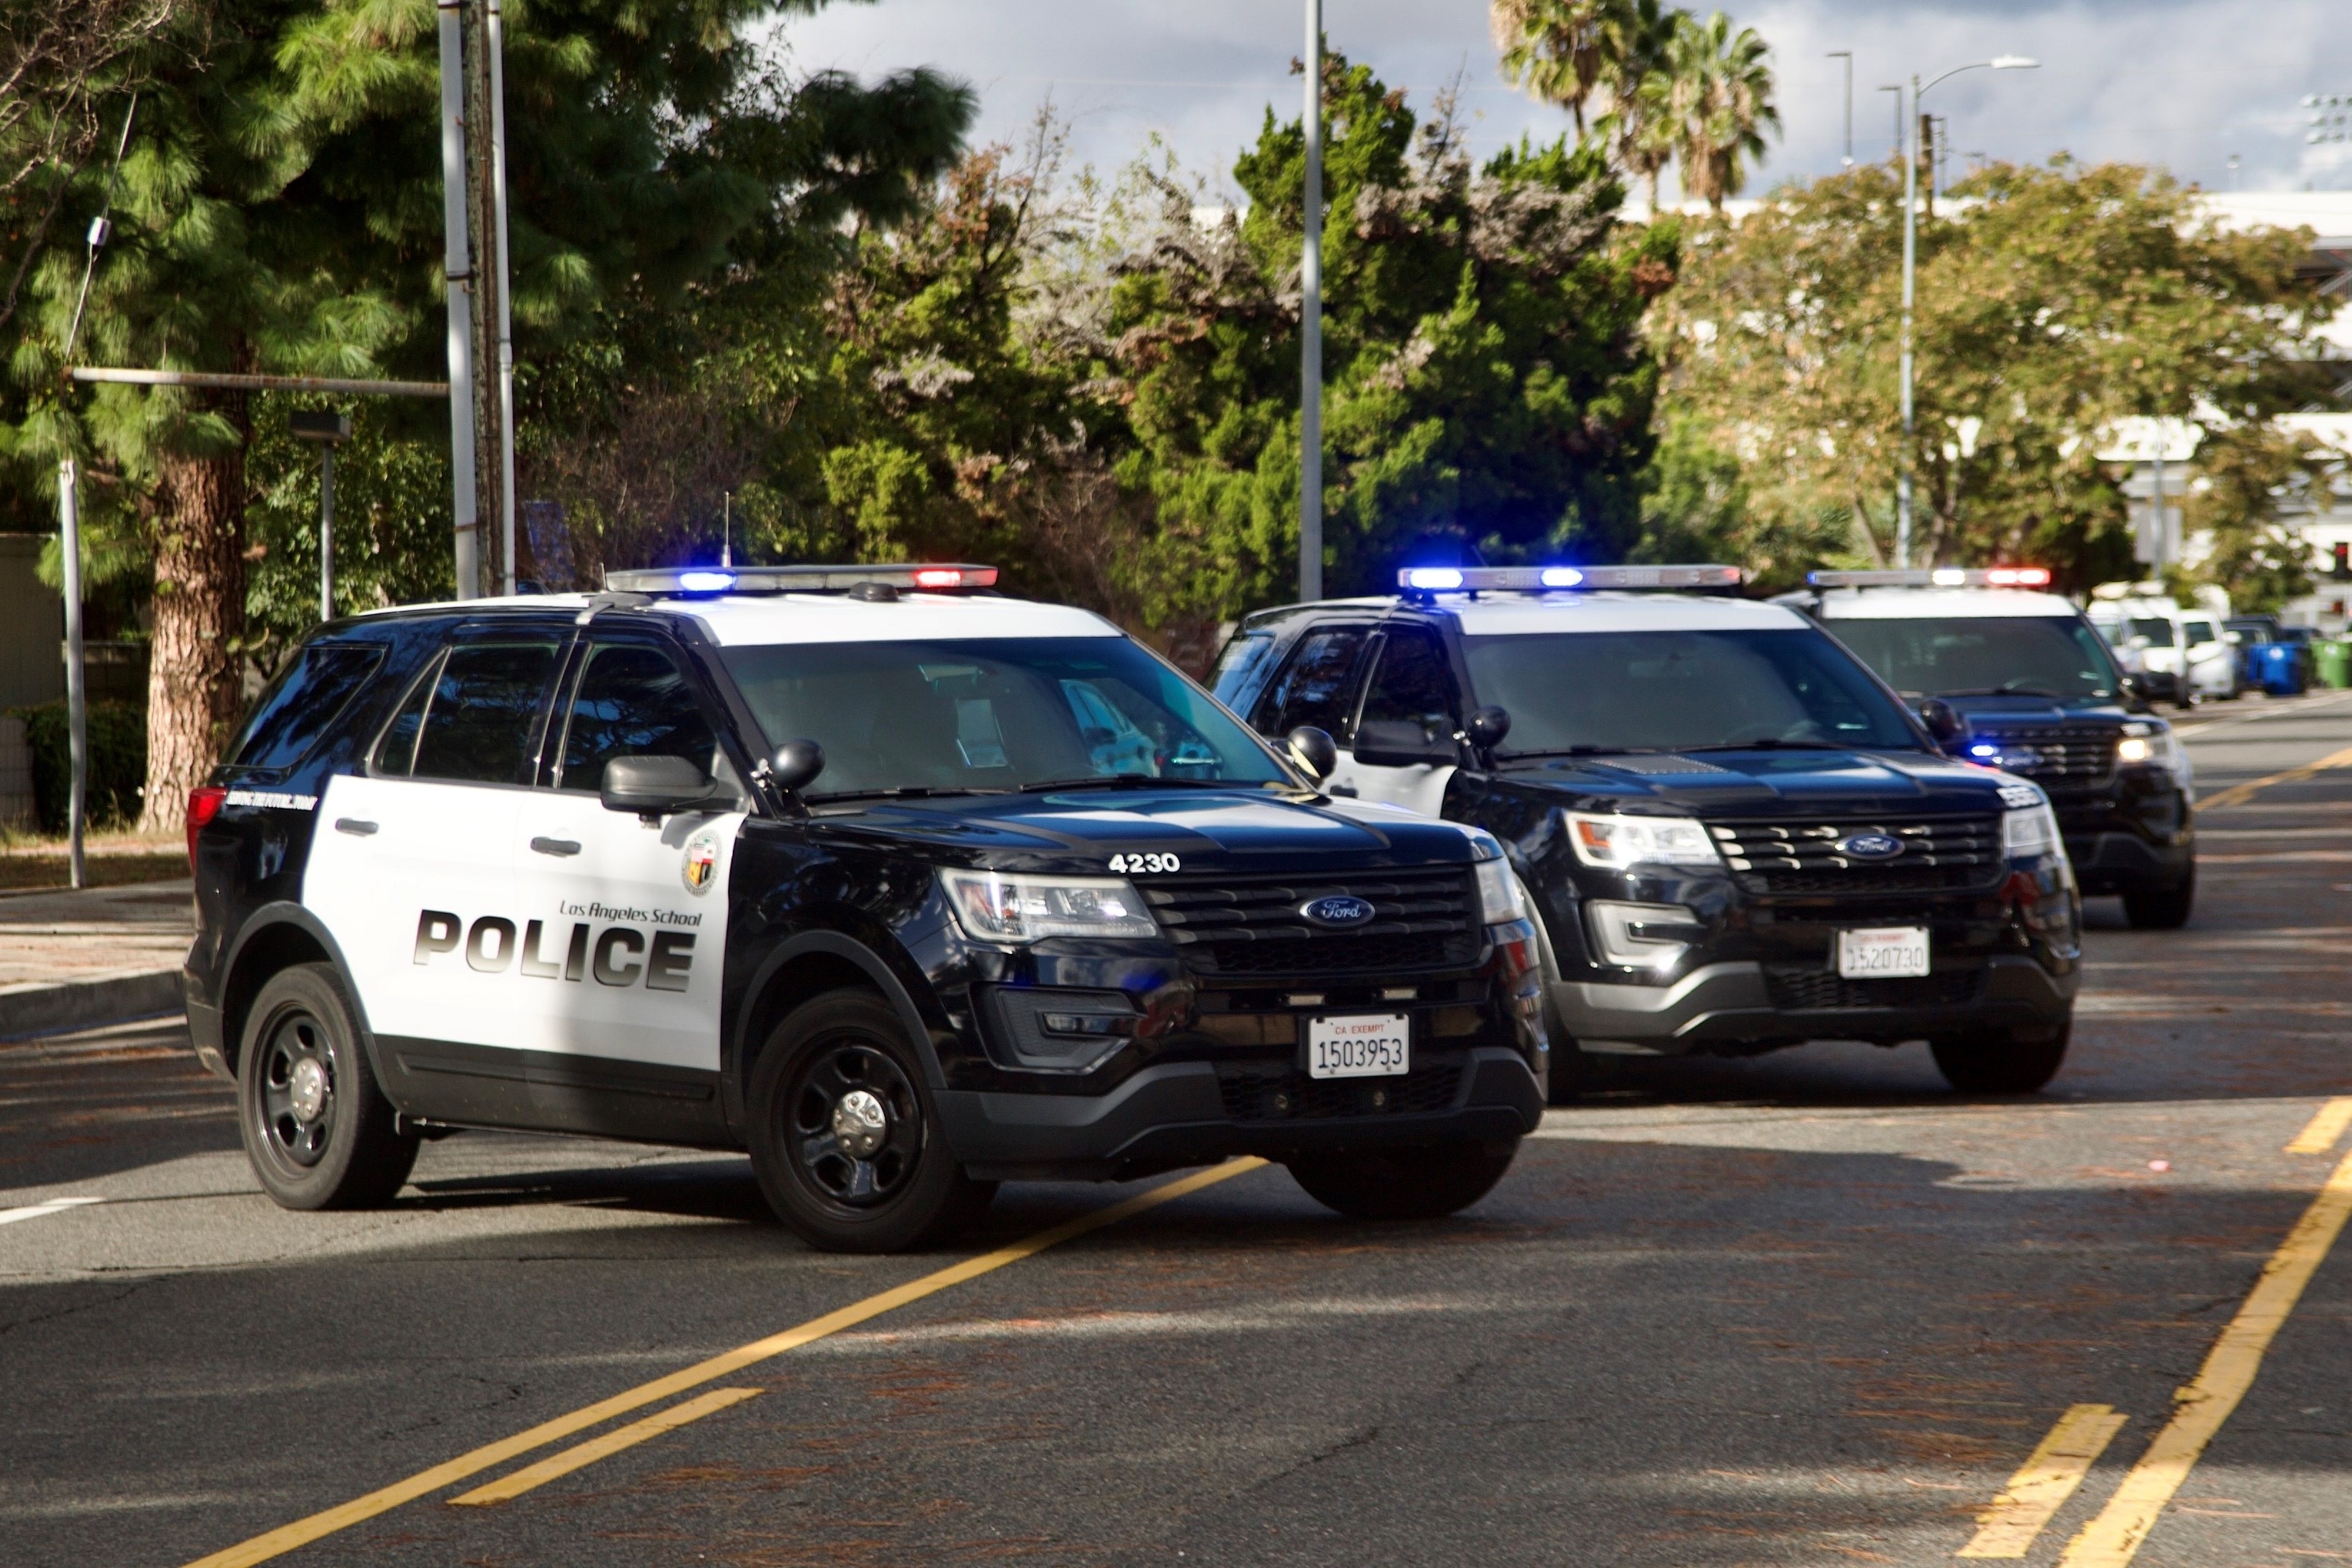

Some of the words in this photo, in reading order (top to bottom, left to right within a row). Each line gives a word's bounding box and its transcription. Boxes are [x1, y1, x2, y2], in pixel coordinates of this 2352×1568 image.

[1108, 852, 1181, 873] 4230
[560, 899, 586, 916] Los
[589, 902, 649, 922] Angeles
[651, 908, 703, 927] School
[1320, 900, 1362, 919] Ford
[413, 909, 697, 992] POLICE
[1335, 1025, 1347, 1035] CA
[1352, 1024, 1385, 1035] EXEMPT
[1318, 1038, 1402, 1069] 1503953
